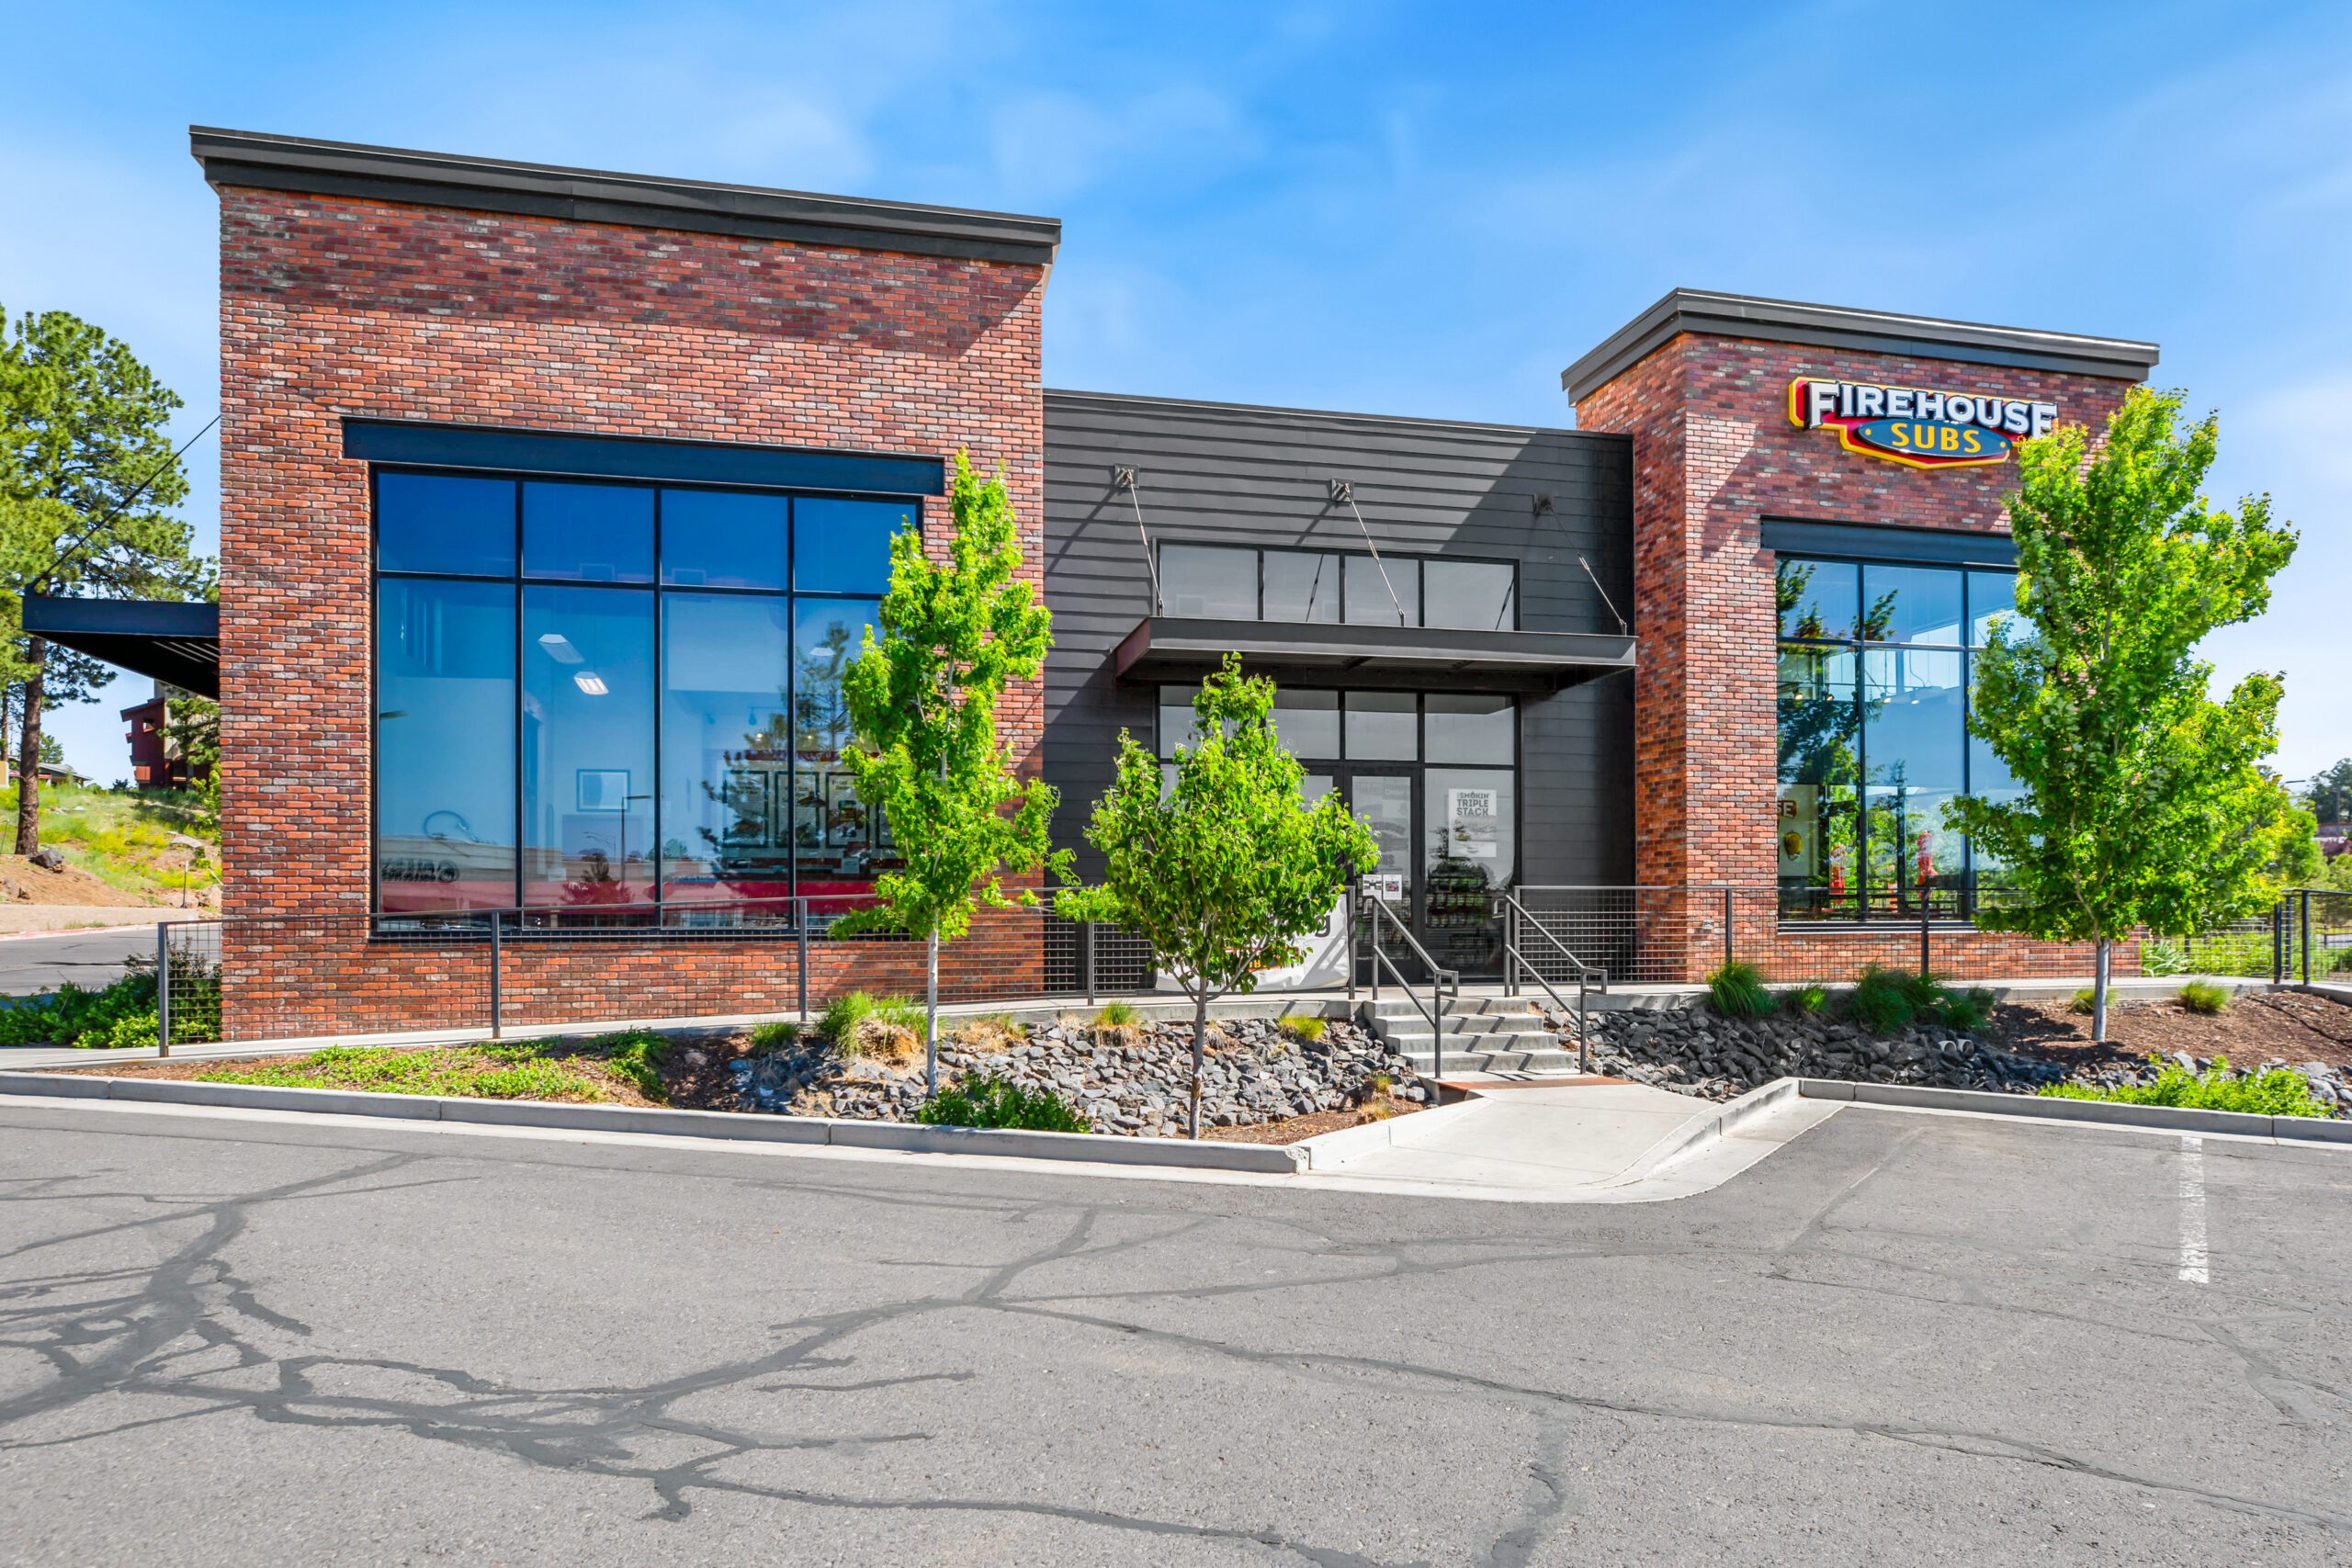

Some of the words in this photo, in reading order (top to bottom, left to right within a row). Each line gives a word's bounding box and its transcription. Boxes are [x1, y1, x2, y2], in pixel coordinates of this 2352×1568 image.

[1807, 380, 2058, 439] FIREHOUSE
[1891, 422, 1982, 454] SUBS
[1456, 798, 1489, 807] TRIPLE
[1456, 807, 1488, 816] STACK
